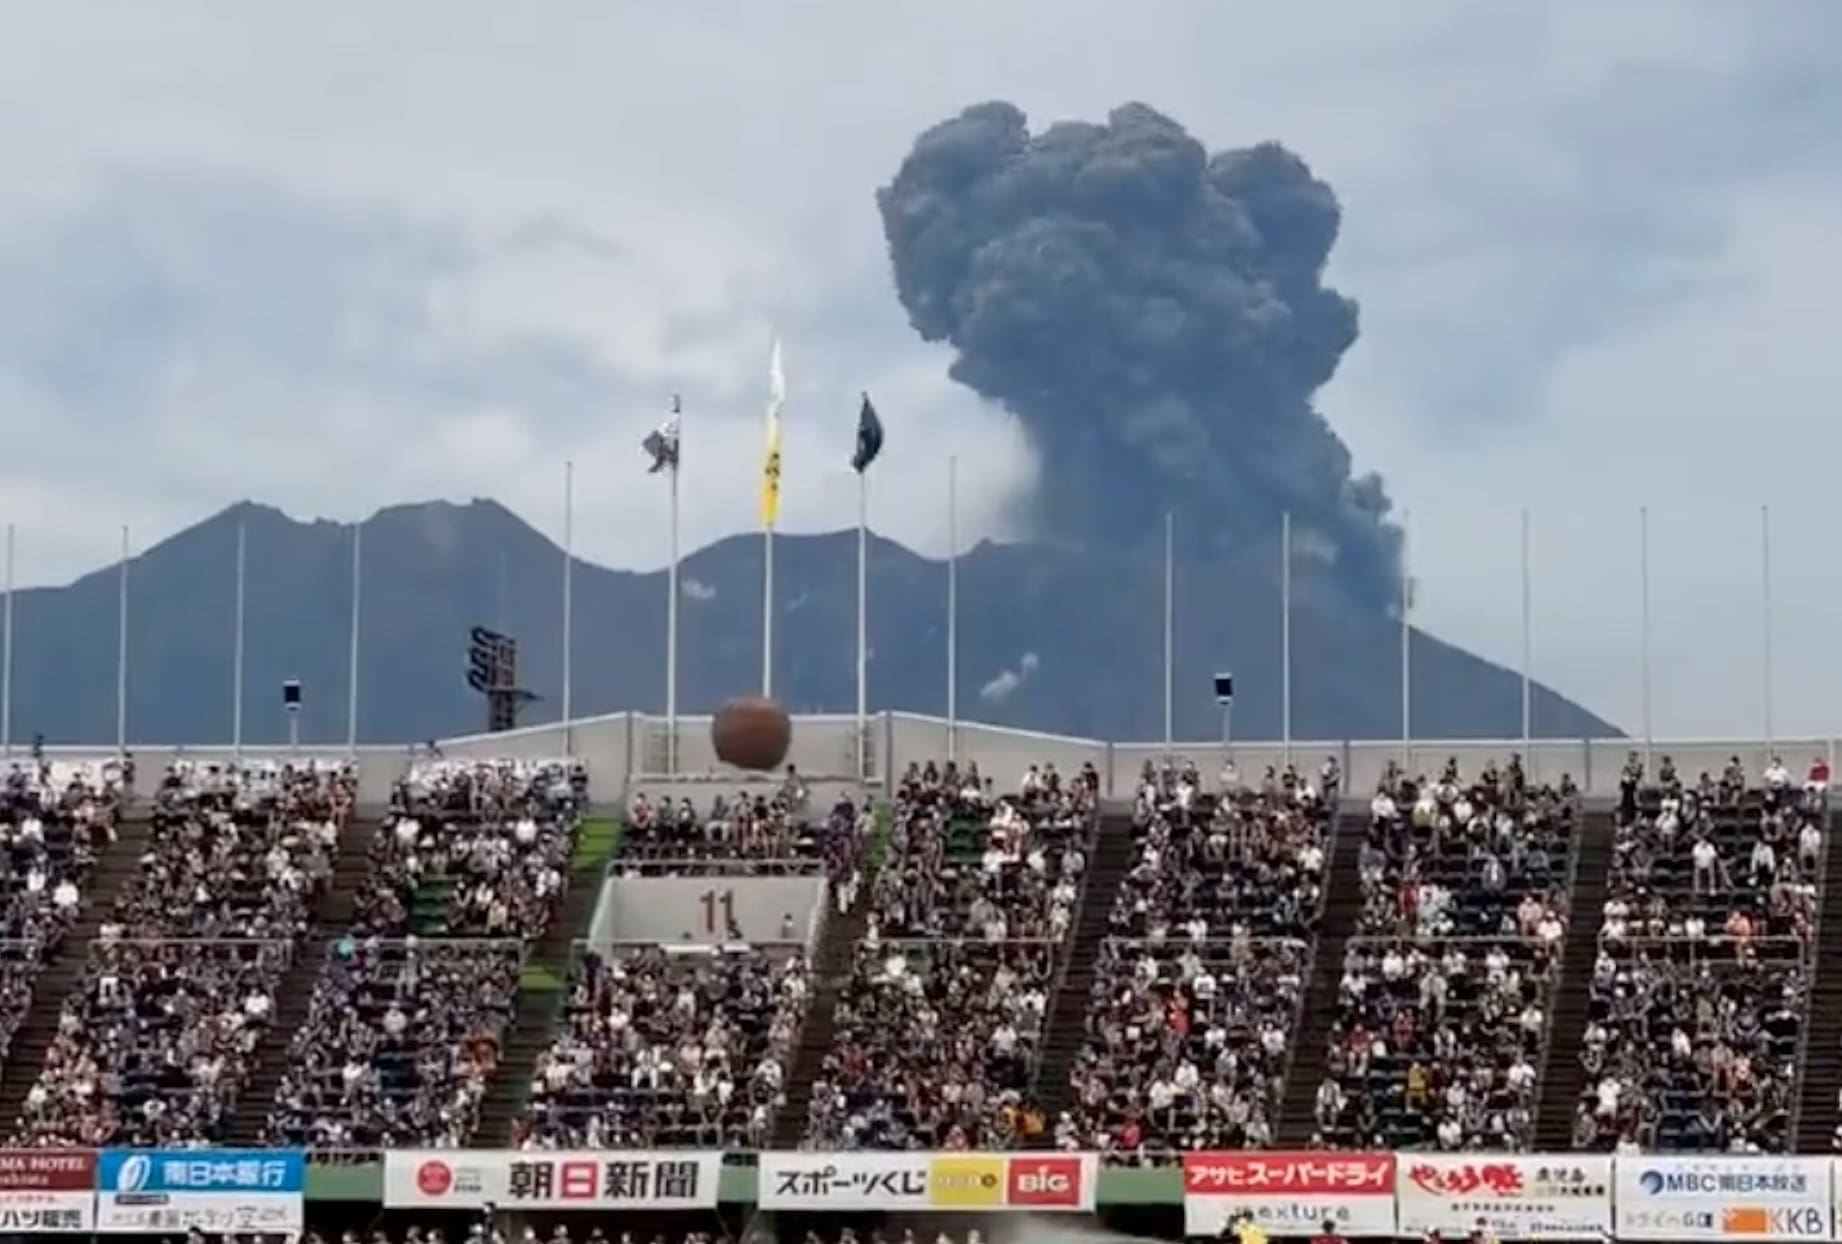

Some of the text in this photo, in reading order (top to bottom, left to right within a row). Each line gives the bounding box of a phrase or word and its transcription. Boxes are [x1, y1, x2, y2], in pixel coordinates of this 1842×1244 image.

[698, 888, 736, 934] 11
[30, 1156, 88, 1172] HOTEL
[163, 1160, 287, 1186] 南日本銀行
[1190, 1161, 1391, 1186] アサヒスーパードライ
[507, 1161, 700, 1199] 朝日新聞
[775, 1165, 927, 1196] スポーツくじ
[1666, 1172, 1807, 1195] MBC南日本放送
[1769, 1208, 1824, 1235] KKB
